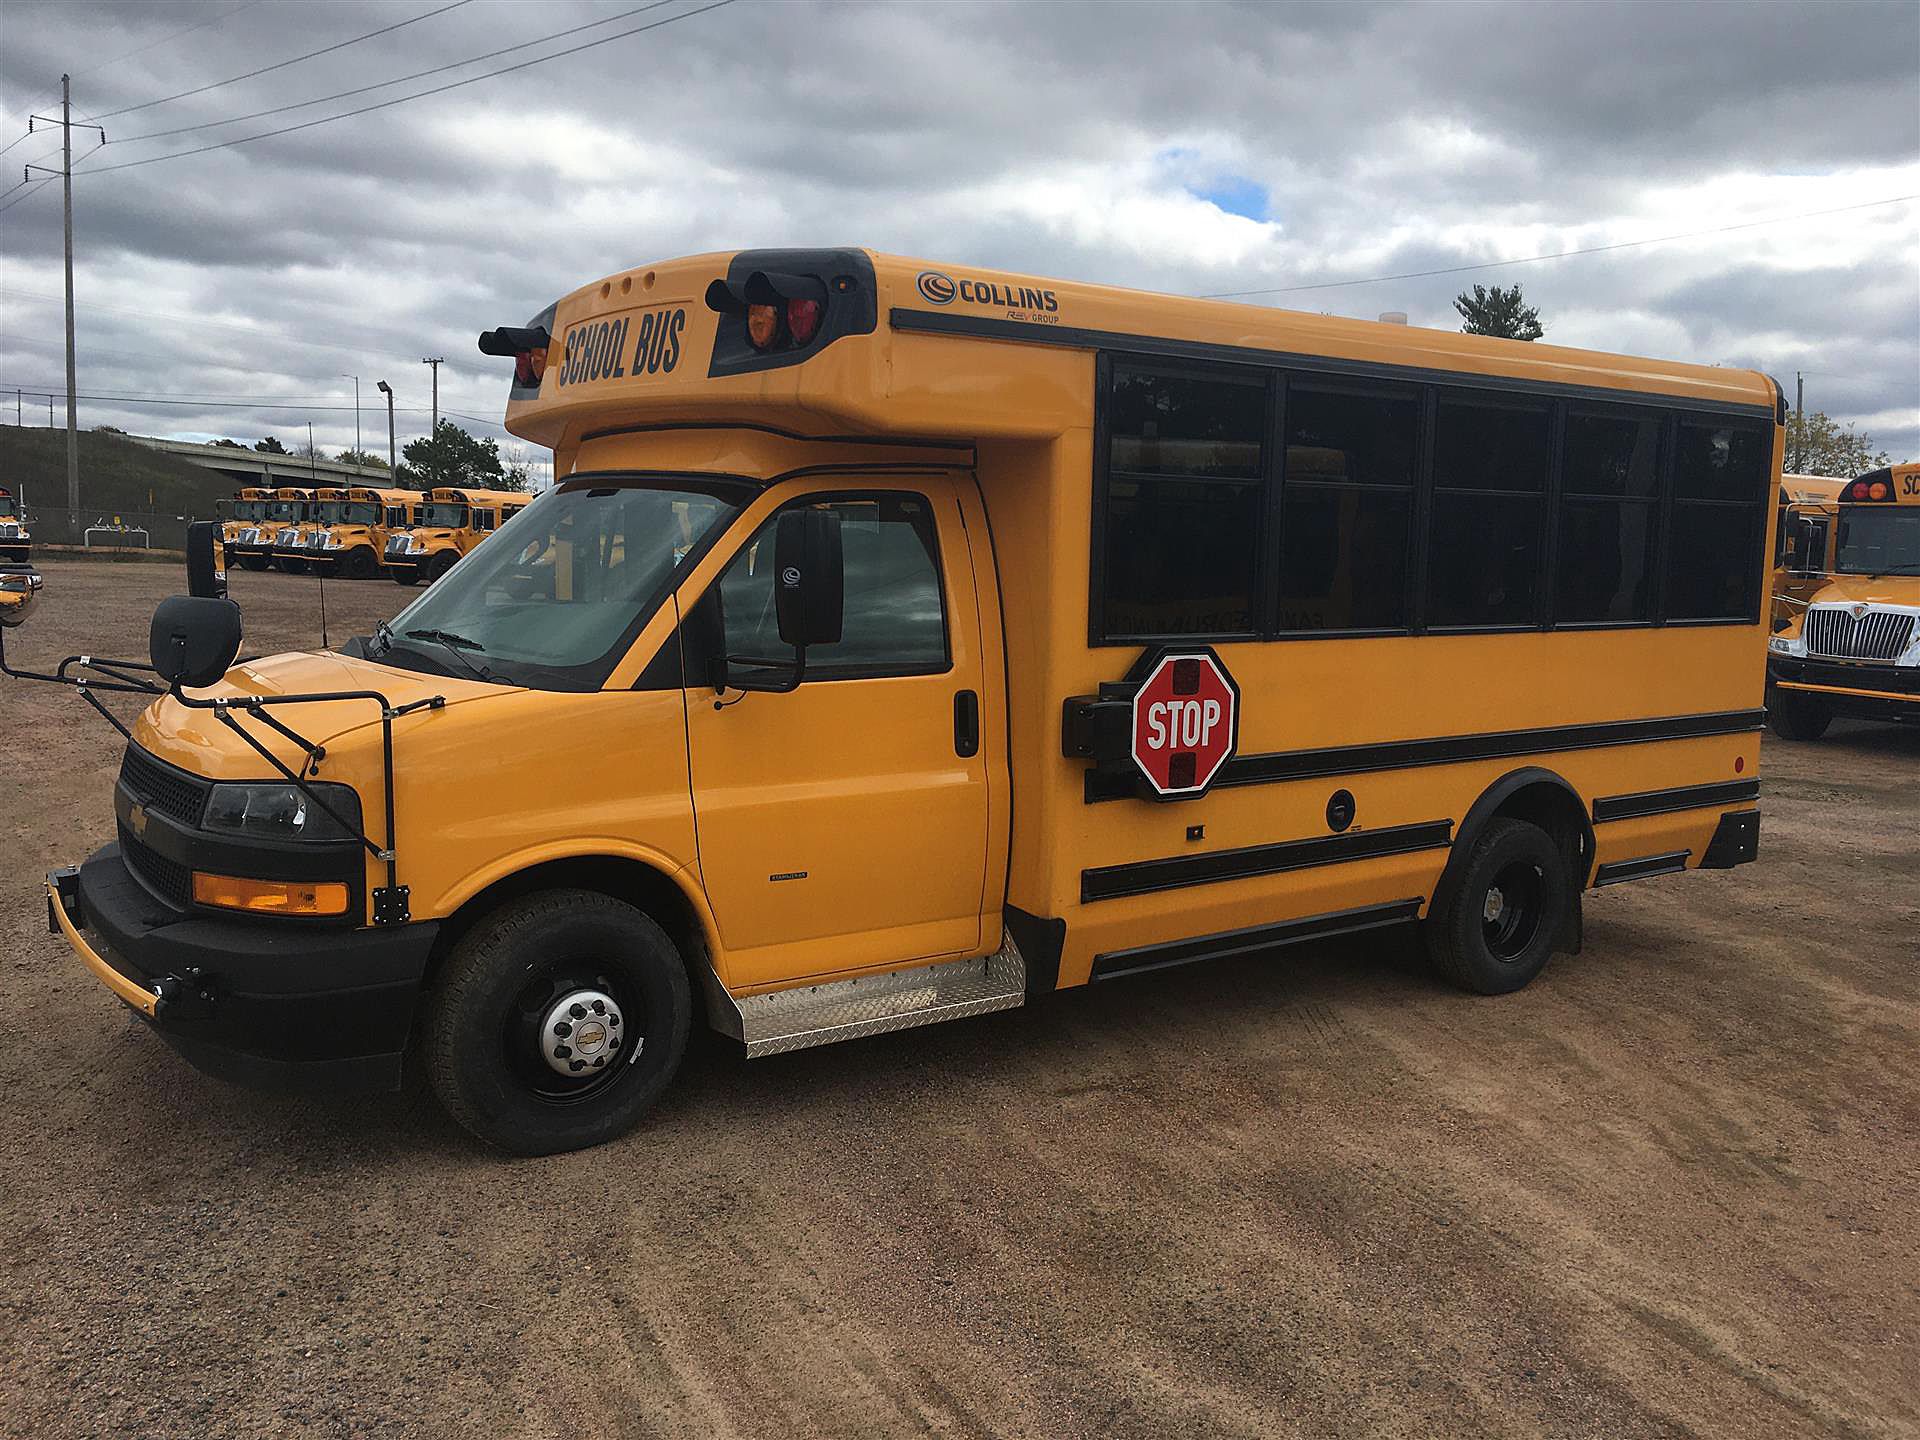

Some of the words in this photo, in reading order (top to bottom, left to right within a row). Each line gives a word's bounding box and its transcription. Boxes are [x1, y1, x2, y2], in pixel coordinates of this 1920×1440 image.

[960, 279, 1058, 312] COLLINS
[1007, 311, 1030, 321] REV
[1032, 314, 1059, 324] GROUP
[560, 317, 630, 387] SCHOOL
[632, 308, 685, 376] BUS
[1147, 699, 1220, 749] STOP
